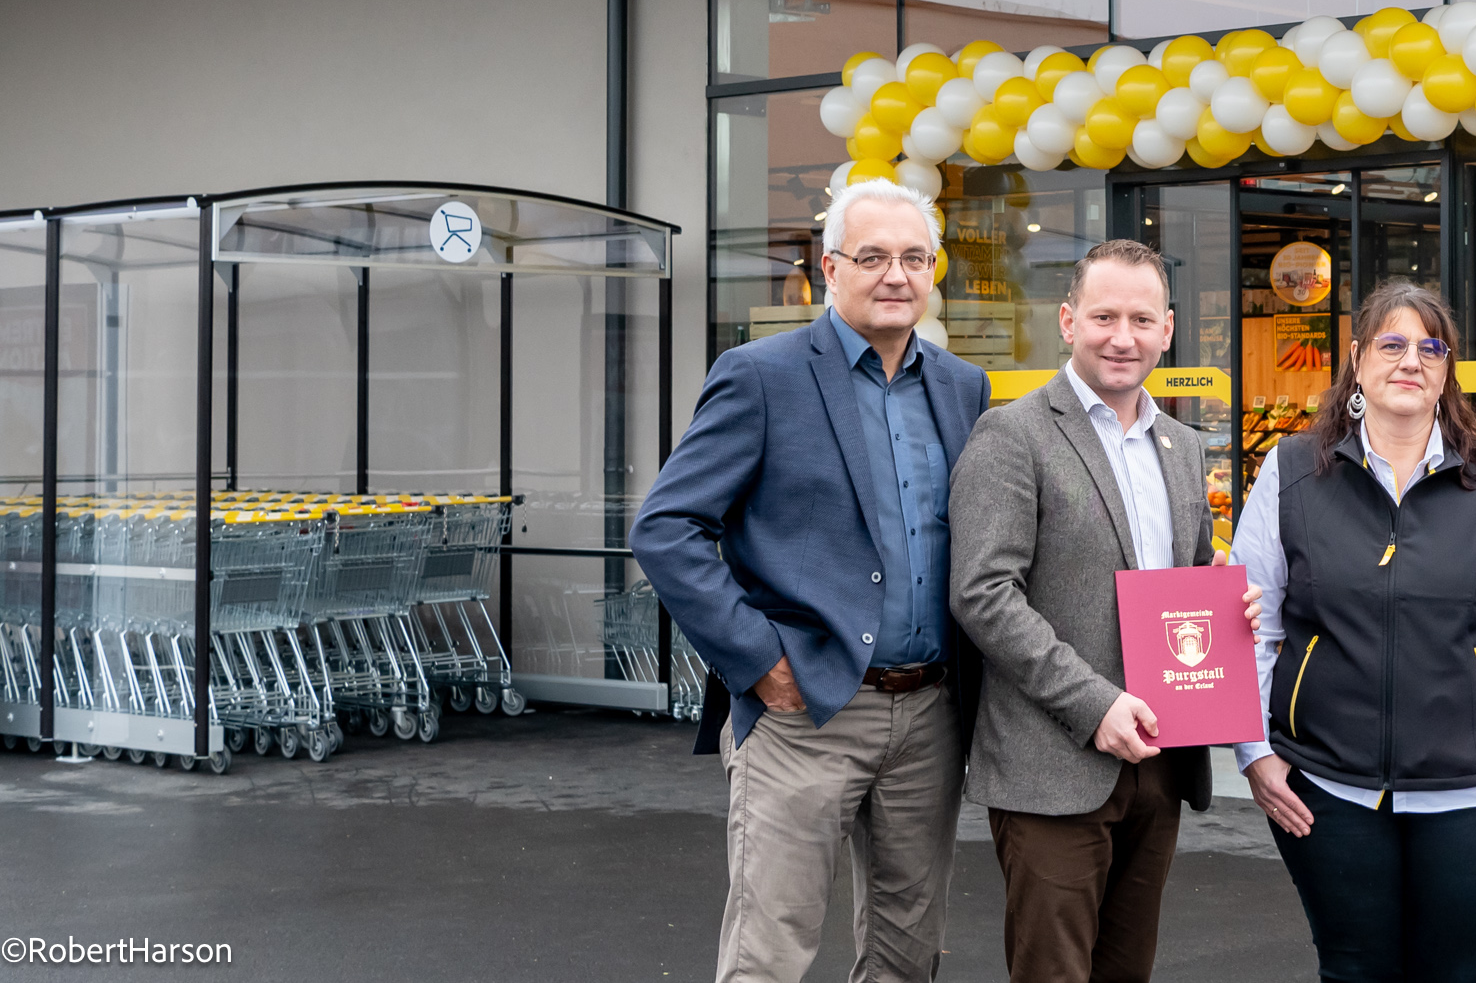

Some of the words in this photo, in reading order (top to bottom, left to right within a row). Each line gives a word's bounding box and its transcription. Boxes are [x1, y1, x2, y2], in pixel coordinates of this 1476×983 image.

[956, 227, 1007, 245] VOLLER
[965, 279, 1007, 295] LEBEN
[1276, 324, 1310, 332] HÖCHSTEN
[1276, 331, 1327, 339] BIO-STANDARDS
[1166, 377, 1213, 387] HERZLICH
[1161, 609, 1213, 619] Marktgemeinde
[1163, 667, 1224, 684] Purgstall
[1195, 682, 1214, 690] Erlauf
